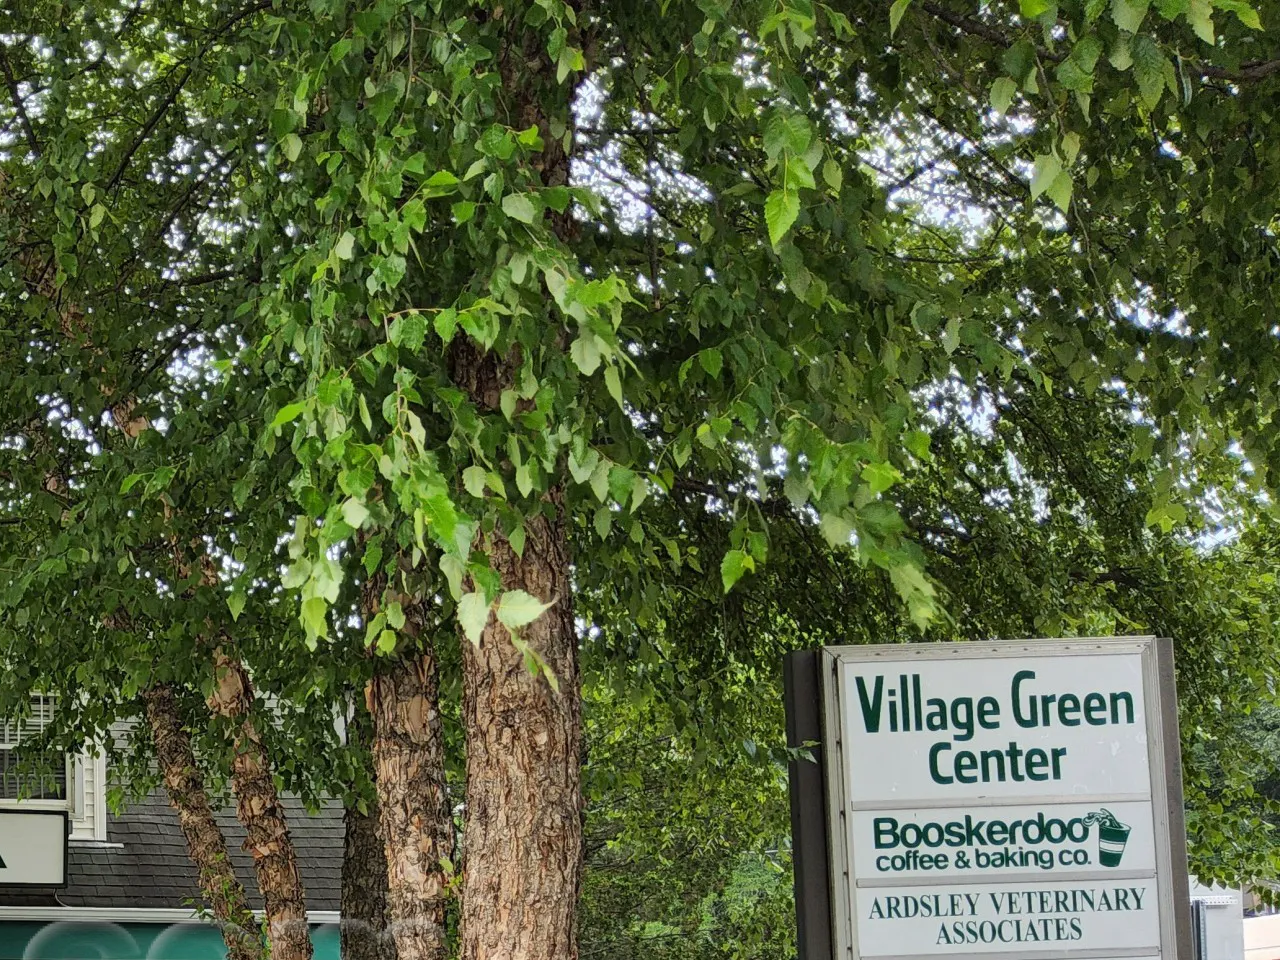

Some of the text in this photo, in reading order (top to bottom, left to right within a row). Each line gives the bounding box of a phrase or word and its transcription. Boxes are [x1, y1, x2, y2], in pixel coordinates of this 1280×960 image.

[854, 669, 1135, 742] Village Green
[928, 741, 1067, 785] Center
[873, 812, 1090, 850] Booskerdoo
[875, 845, 1093, 872] coffee & baking co.
[868, 887, 1147, 920] ARDSLEY VETERINARY
[936, 917, 1083, 945] ASSOCIATES
